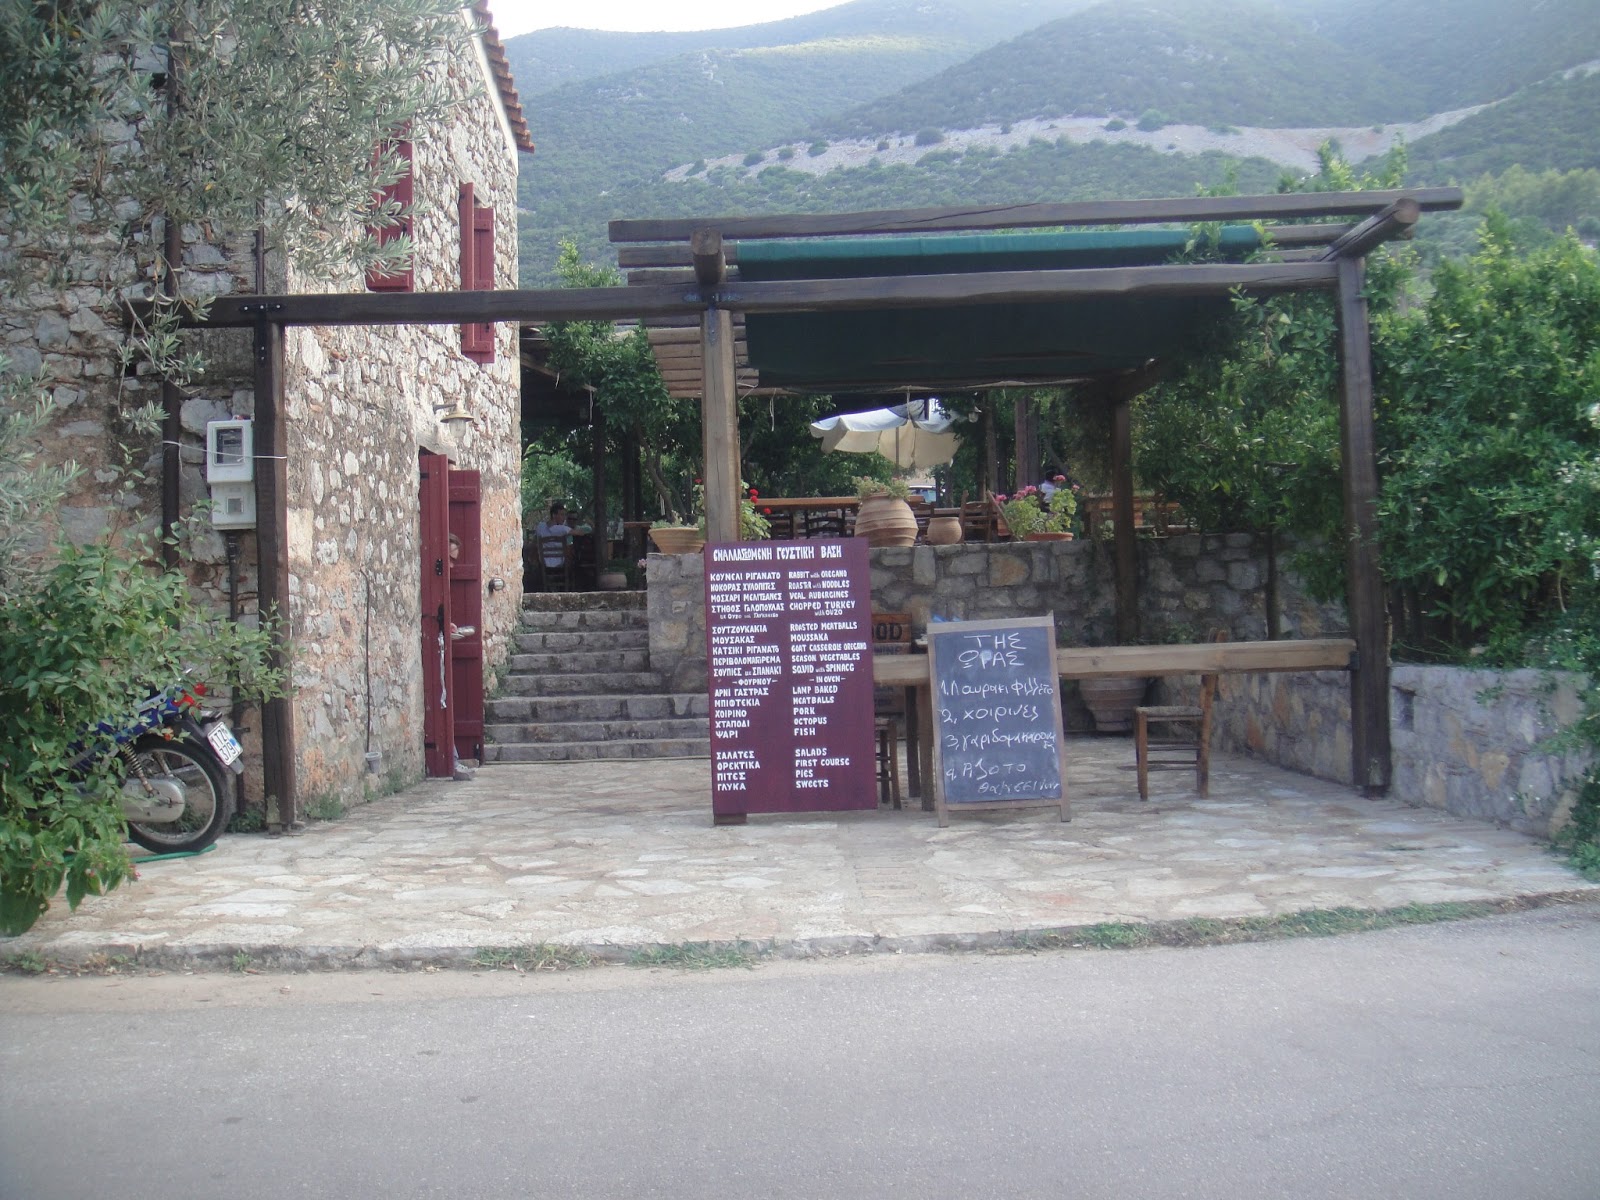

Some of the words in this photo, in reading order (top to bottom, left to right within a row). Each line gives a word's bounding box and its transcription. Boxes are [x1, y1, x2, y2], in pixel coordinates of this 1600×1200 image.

[776, 545, 815, 560] ΓΕΥΣΤΙΚΗ
[820, 544, 842, 559] ΒΑΣΗ
[710, 573, 743, 582] ΚΟΥΝΕΛΙ
[745, 571, 781, 581] ΡΙΓΑΝΑΤΟ
[788, 570, 810, 579] RABBIT
[820, 569, 847, 578] OREGANO
[710, 583, 742, 593] ΚΟΚΟΡΑΣ
[822, 580, 850, 589] NOODLES
[710, 593, 741, 603] ΜΟΣΧΑΡΙ
[789, 592, 806, 600] VEAL
[808, 590, 849, 600] AUBERGINES
[711, 604, 741, 613] ΣΤΗΘΟΣ
[789, 602, 821, 611] CHOPPED
[824, 600, 856, 609] TURKEY
[815, 609, 825, 617] with
[712, 624, 768, 635] ΣΟΥΤΖΟΥΚΑΚΙΑ
[790, 622, 819, 632] ROASTED
[821, 621, 858, 631] MEATBALLS
[712, 635, 755, 645] ΜΟΥΣΑΚΑΣ
[790, 633, 829, 642] MOUSSAKA
[963, 632, 1027, 650] ΤΗΣ
[712, 646, 743, 656] ΚΑΤΣΙΚΙ
[746, 645, 780, 655] ΡΙΓΑΝΑΤΟ
[791, 644, 807, 653] GOAT
[791, 654, 817, 663] SEASON
[819, 653, 860, 661] VEGETABLES
[713, 667, 742, 677] ΣΟΥΠΙΕΣ
[752, 666, 782, 676] ΣΠΑΝΑΚΙ
[792, 664, 815, 674] SQUID
[714, 688, 731, 698] ΑΡΝΙ
[734, 687, 769, 697] ΓΑΣΤΡΑΣ
[814, 685, 838, 694] BAKED
[714, 698, 761, 708] ΜΠΙΦΤΕΚΙΑ
[793, 696, 835, 705] MEATBALLS
[715, 709, 747, 719] ΧΟΙΡΙΝΟ
[793, 707, 815, 716] PORK
[715, 719, 750, 729] ΧΤΑΠΟΔΙ
[793, 717, 828, 726] OCTOPUS
[715, 730, 738, 739] ΨΑΡΙ
[794, 727, 816, 737] FISH
[716, 750, 755, 760] ΣΑΛΑΤΕΣ
[795, 747, 828, 757] SALADS
[717, 760, 761, 771] ΟΡΕΚΤΙΚΑ
[795, 759, 817, 768] FIRST
[820, 757, 850, 766] COURSE
[717, 771, 746, 781] ΠΙΤΕΣ
[795, 769, 814, 778] PIES
[717, 782, 747, 792] ΓΛΥΚΑ
[795, 779, 829, 789] SWEETS
